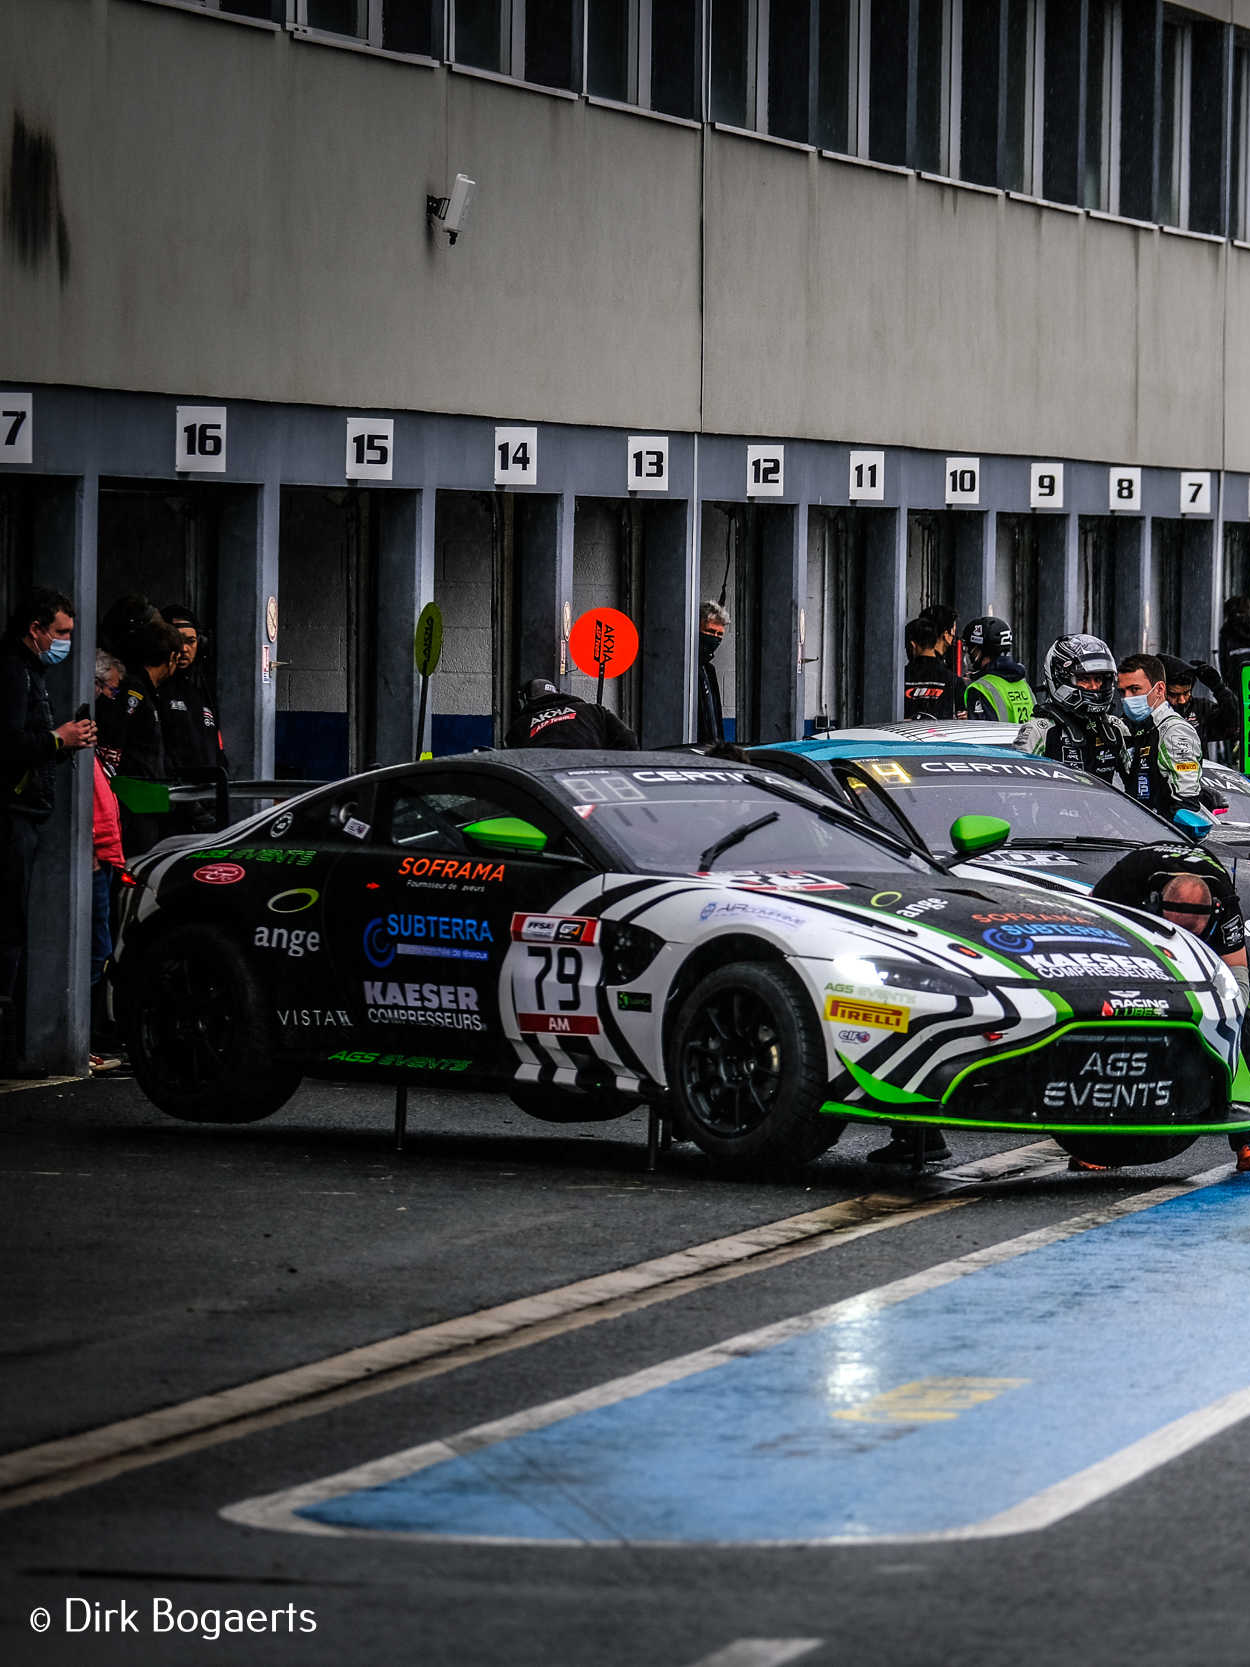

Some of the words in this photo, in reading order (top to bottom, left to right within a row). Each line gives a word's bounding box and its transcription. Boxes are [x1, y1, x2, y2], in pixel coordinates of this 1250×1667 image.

[183, 422, 223, 457] 16
[352, 433, 389, 465] 15
[499, 441, 531, 471] 14
[632, 450, 664, 478] 13
[751, 458, 781, 484] 12
[854, 463, 877, 488] 11
[949, 469, 976, 493] 10
[1038, 474, 1056, 497] 9
[1117, 478, 1134, 500] 8
[1188, 482, 1203, 503] 7
[920, 762, 1080, 784] CERTINA
[397, 857, 505, 882] SOFRAMA
[895, 897, 948, 919] ange
[971, 911, 1096, 925] SOFRAMA
[387, 913, 494, 943] SUBTERRA
[1001, 923, 1128, 942] SUBTERRA
[255, 926, 320, 957] ange
[1020, 952, 1162, 972] KAESER
[528, 946, 582, 1011] 79
[824, 982, 854, 995] AGS
[363, 980, 480, 1011] KAESER
[1111, 998, 1170, 1009] RACING
[367, 1007, 481, 1032] COMPRESSEURS
[548, 1016, 571, 1032] AM
[829, 1000, 904, 1027] PIRELLI
[1114, 1008, 1164, 1017] LUBES
[327, 1050, 381, 1064] AGS
[1079, 1051, 1150, 1077] AGS
[1042, 1080, 1174, 1108] EVENTS
